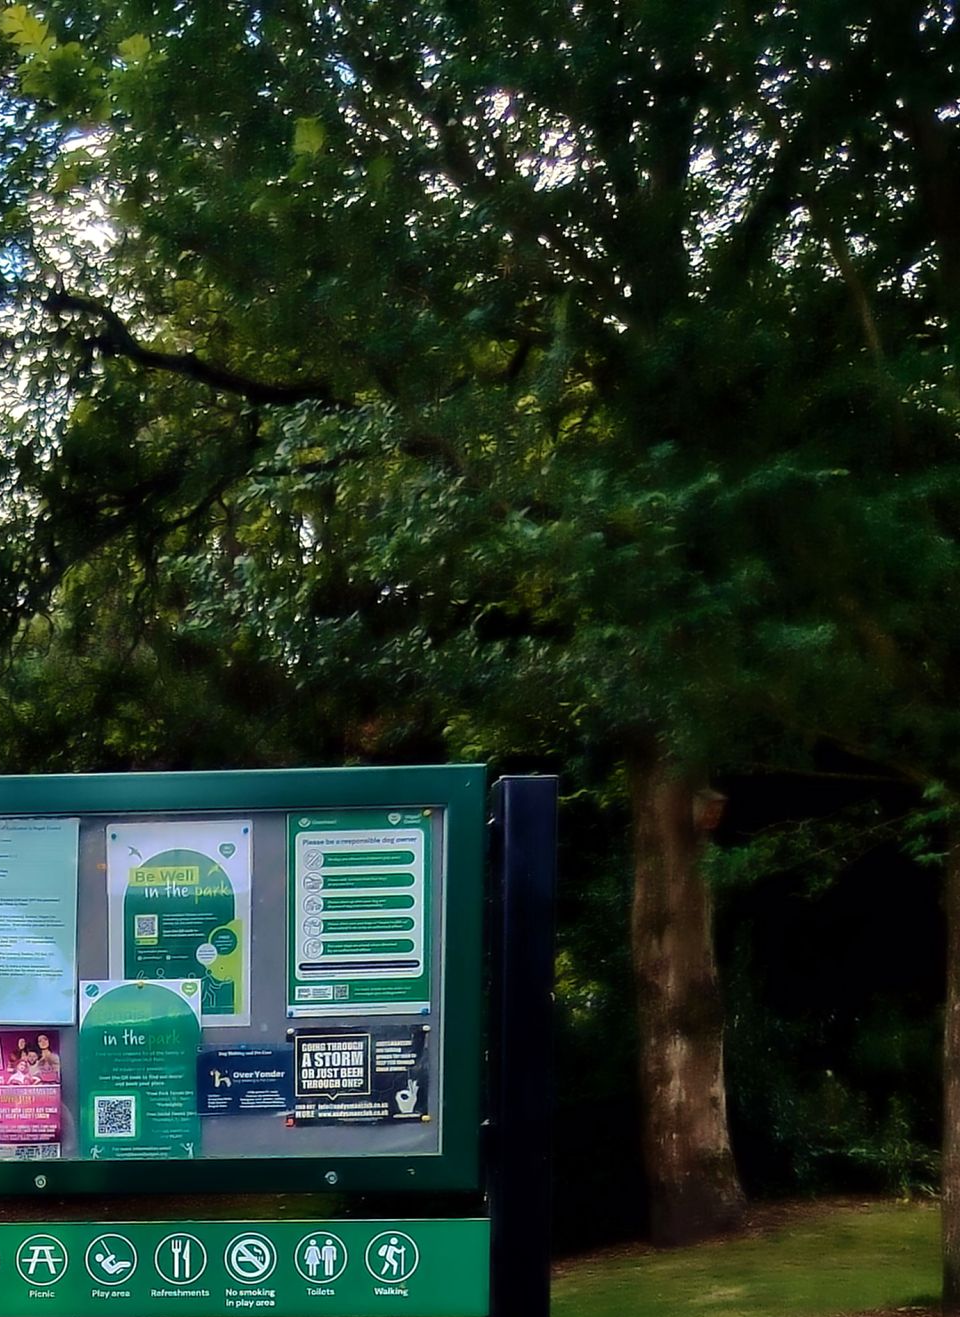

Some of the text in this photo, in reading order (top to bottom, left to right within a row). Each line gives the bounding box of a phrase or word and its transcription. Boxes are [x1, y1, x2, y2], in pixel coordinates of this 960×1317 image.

[135, 869, 194, 883] Be Well
[144, 879, 230, 905] in the park
[103, 1031, 118, 1046] in
[121, 1029, 146, 1045] the
[326, 1041, 364, 1051] THROUGH
[301, 1052, 312, 1068] A
[313, 1051, 364, 1067] STORM
[301, 1067, 364, 1079] OR JUST BEEN
[301, 1078, 364, 1089] THROUGH ONE?
[29, 1289, 55, 1299] Picnic
[91, 1289, 110, 1299] Play
[150, 1288, 210, 1298] Refreshments
[225, 1288, 276, 1299] No smoking
[306, 1287, 335, 1296] Toilets
[374, 1287, 409, 1298] Walking
[225, 1299, 234, 1307] in
[235, 1298, 254, 1309] play
